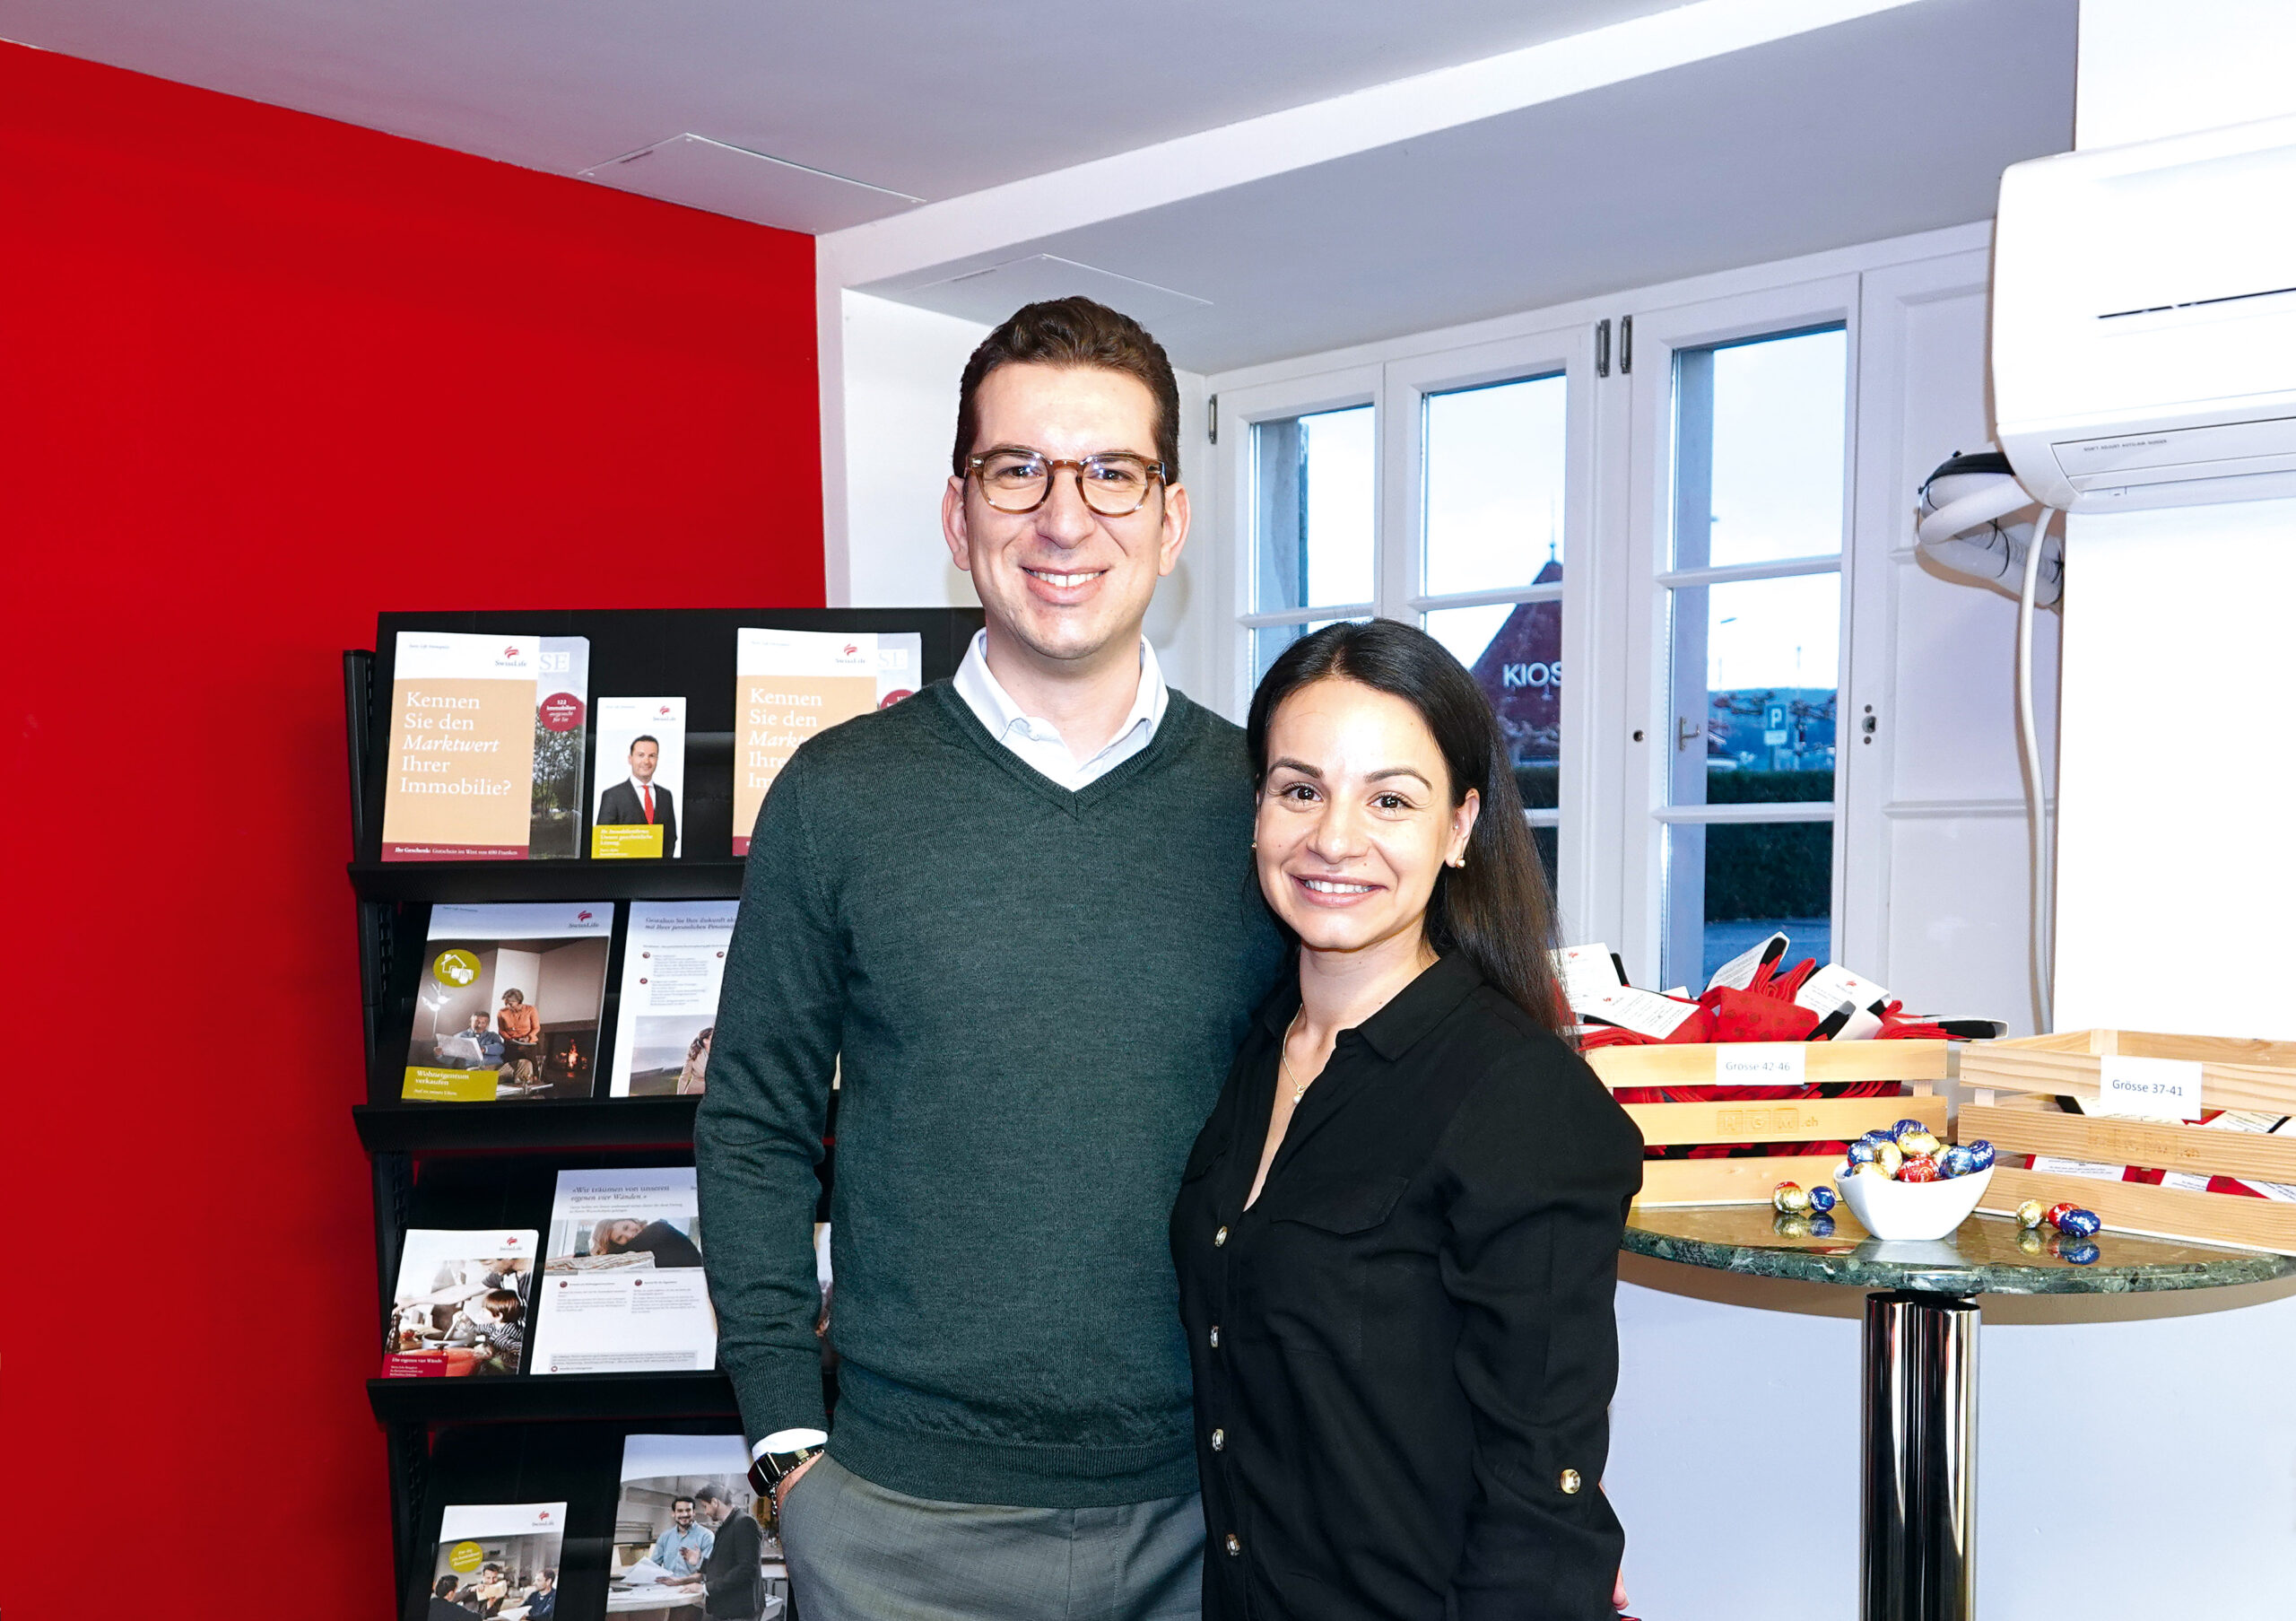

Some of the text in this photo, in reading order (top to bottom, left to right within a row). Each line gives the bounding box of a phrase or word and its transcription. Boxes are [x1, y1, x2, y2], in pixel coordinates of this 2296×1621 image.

[406, 692, 481, 710] Kennen
[750, 687, 822, 707] Kennen
[404, 712, 474, 731] Sie den
[749, 709, 818, 728] Sie den
[1771, 709, 1782, 728] P
[402, 734, 500, 753] Marktwert
[402, 755, 451, 772] Ihrer
[400, 777, 512, 796] Immobilie?
[415, 1077, 448, 1085] verkaufen
[2112, 1079, 2184, 1096] Grösse 37-41
